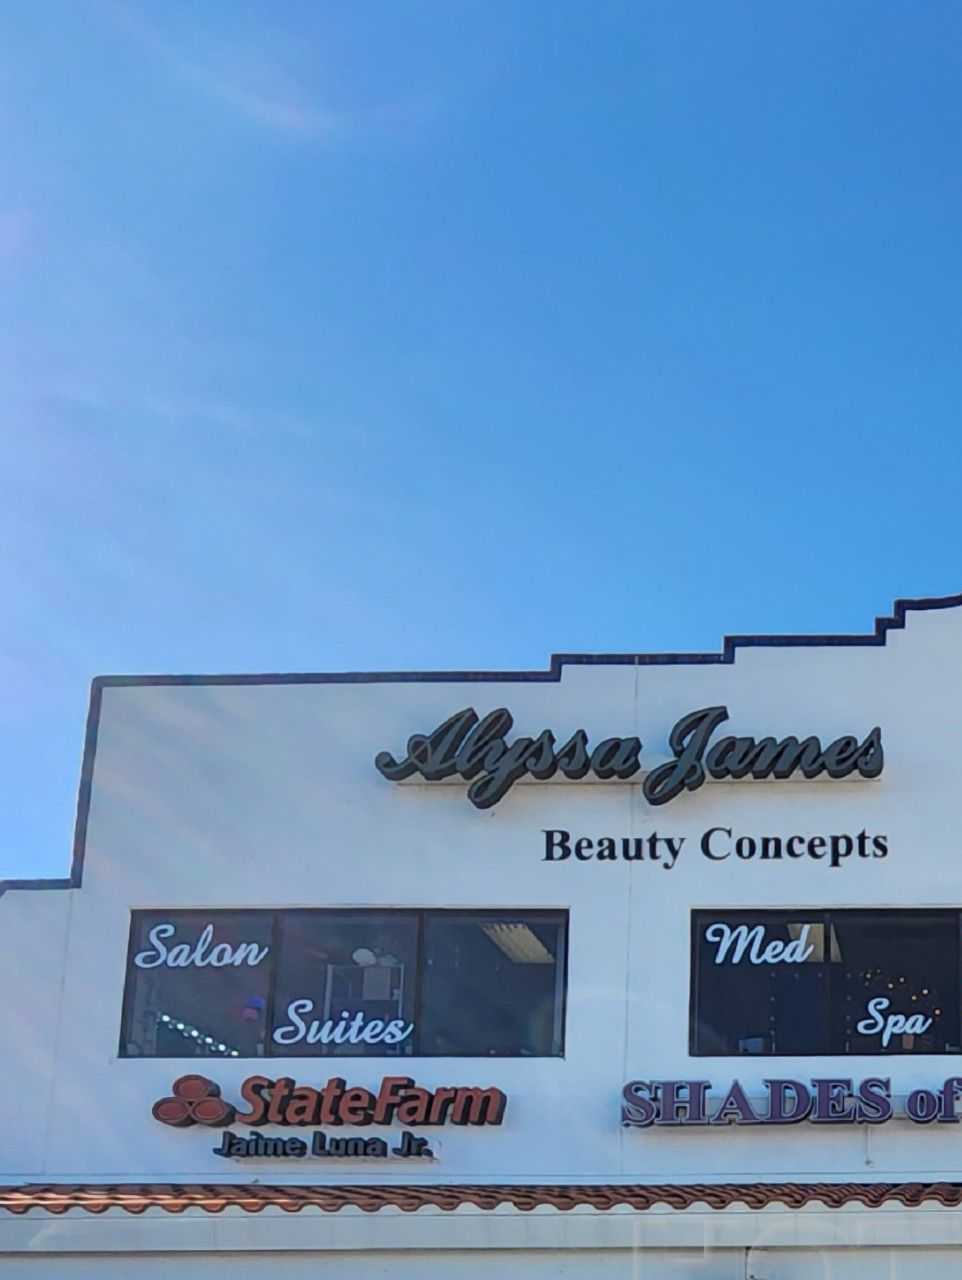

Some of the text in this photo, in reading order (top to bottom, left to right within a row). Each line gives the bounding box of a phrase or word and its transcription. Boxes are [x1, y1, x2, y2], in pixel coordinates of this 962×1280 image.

[375, 706, 884, 809] Alyssa James
[540, 827, 889, 869] Beauty Concepts
[134, 923, 269, 969] Salon
[705, 922, 816, 965] Med
[273, 998, 414, 1045] Suites
[857, 996, 932, 1046] Spa
[621, 1077, 894, 1127] SHADES
[213, 1130, 434, 1157] Jaime Luna Jr.
